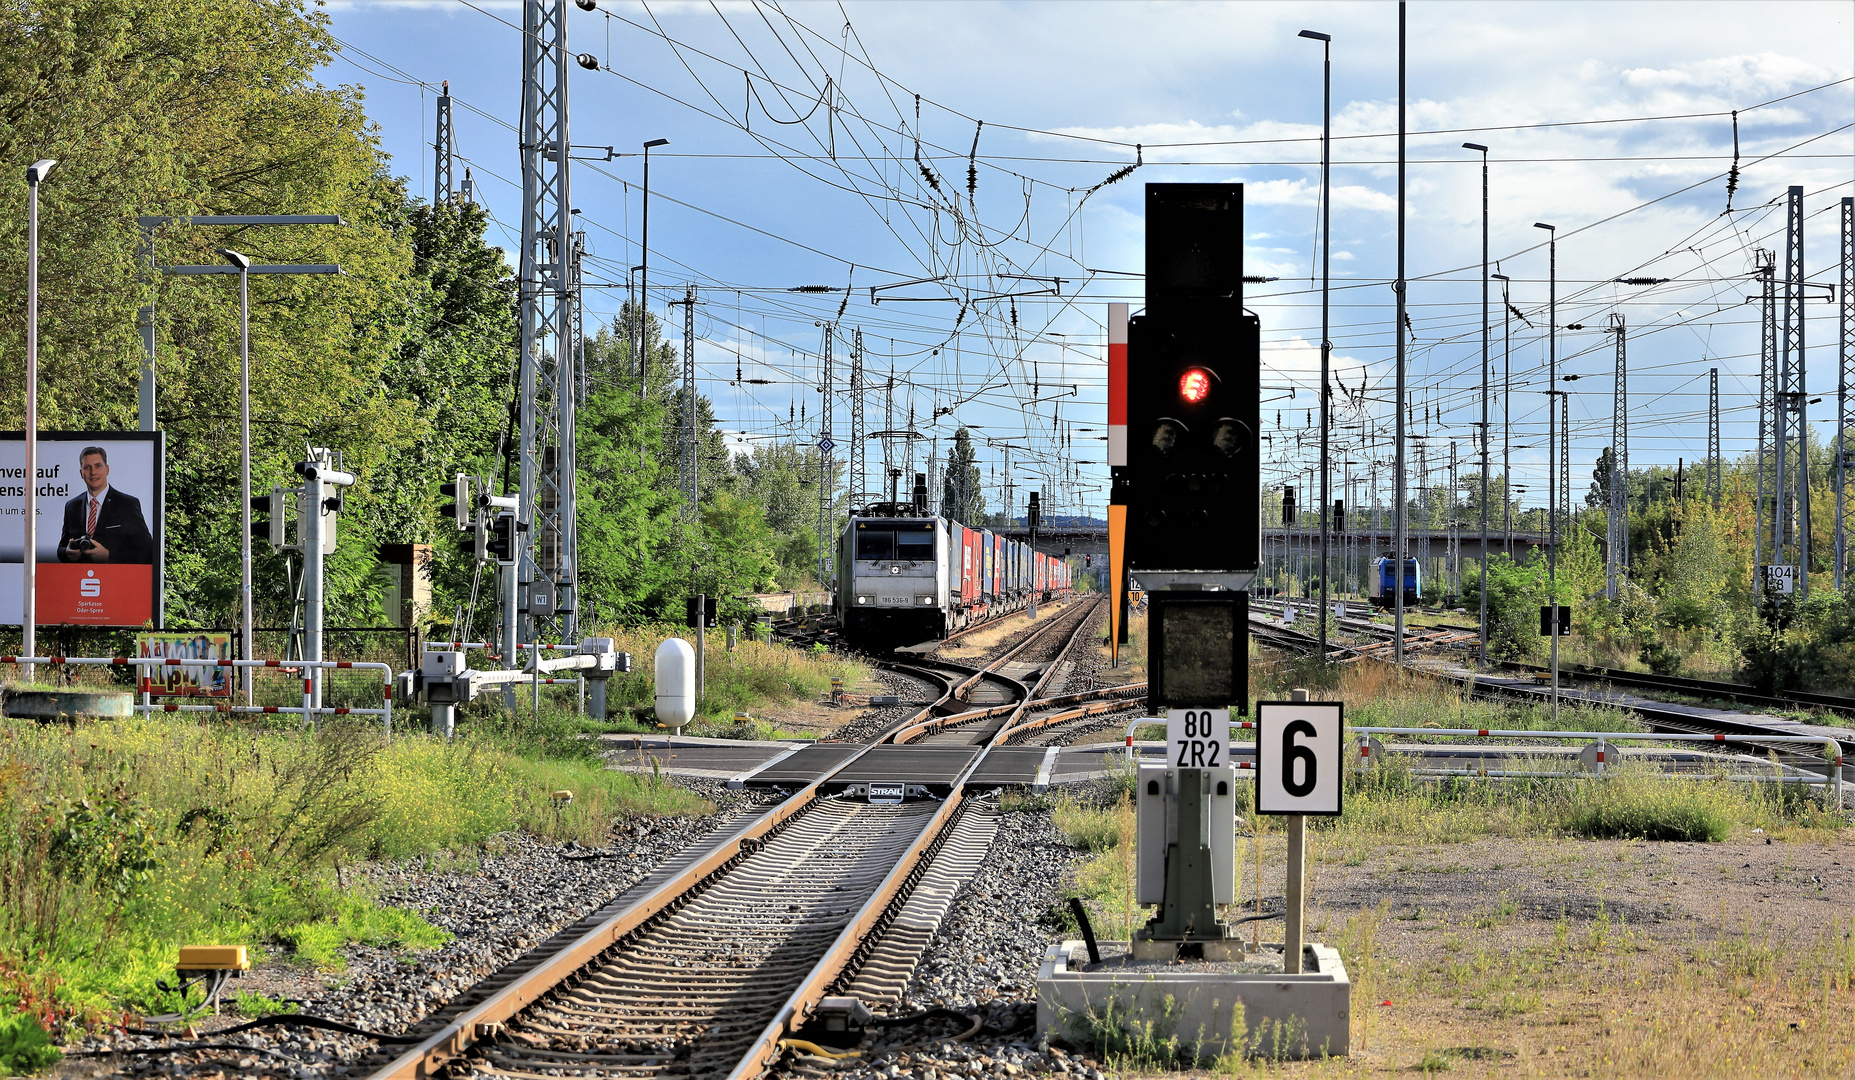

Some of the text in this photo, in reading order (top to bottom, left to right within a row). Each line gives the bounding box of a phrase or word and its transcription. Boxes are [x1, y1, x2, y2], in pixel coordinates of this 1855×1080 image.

[1769, 567, 1791, 578] 104
[537, 595, 546, 603] W1
[1131, 591, 1140, 602] 10
[1184, 710, 1212, 738] 80
[1176, 739, 1220, 767] ZR2
[1282, 719, 1318, 798] 6
[870, 788, 902, 796] STRAIL
